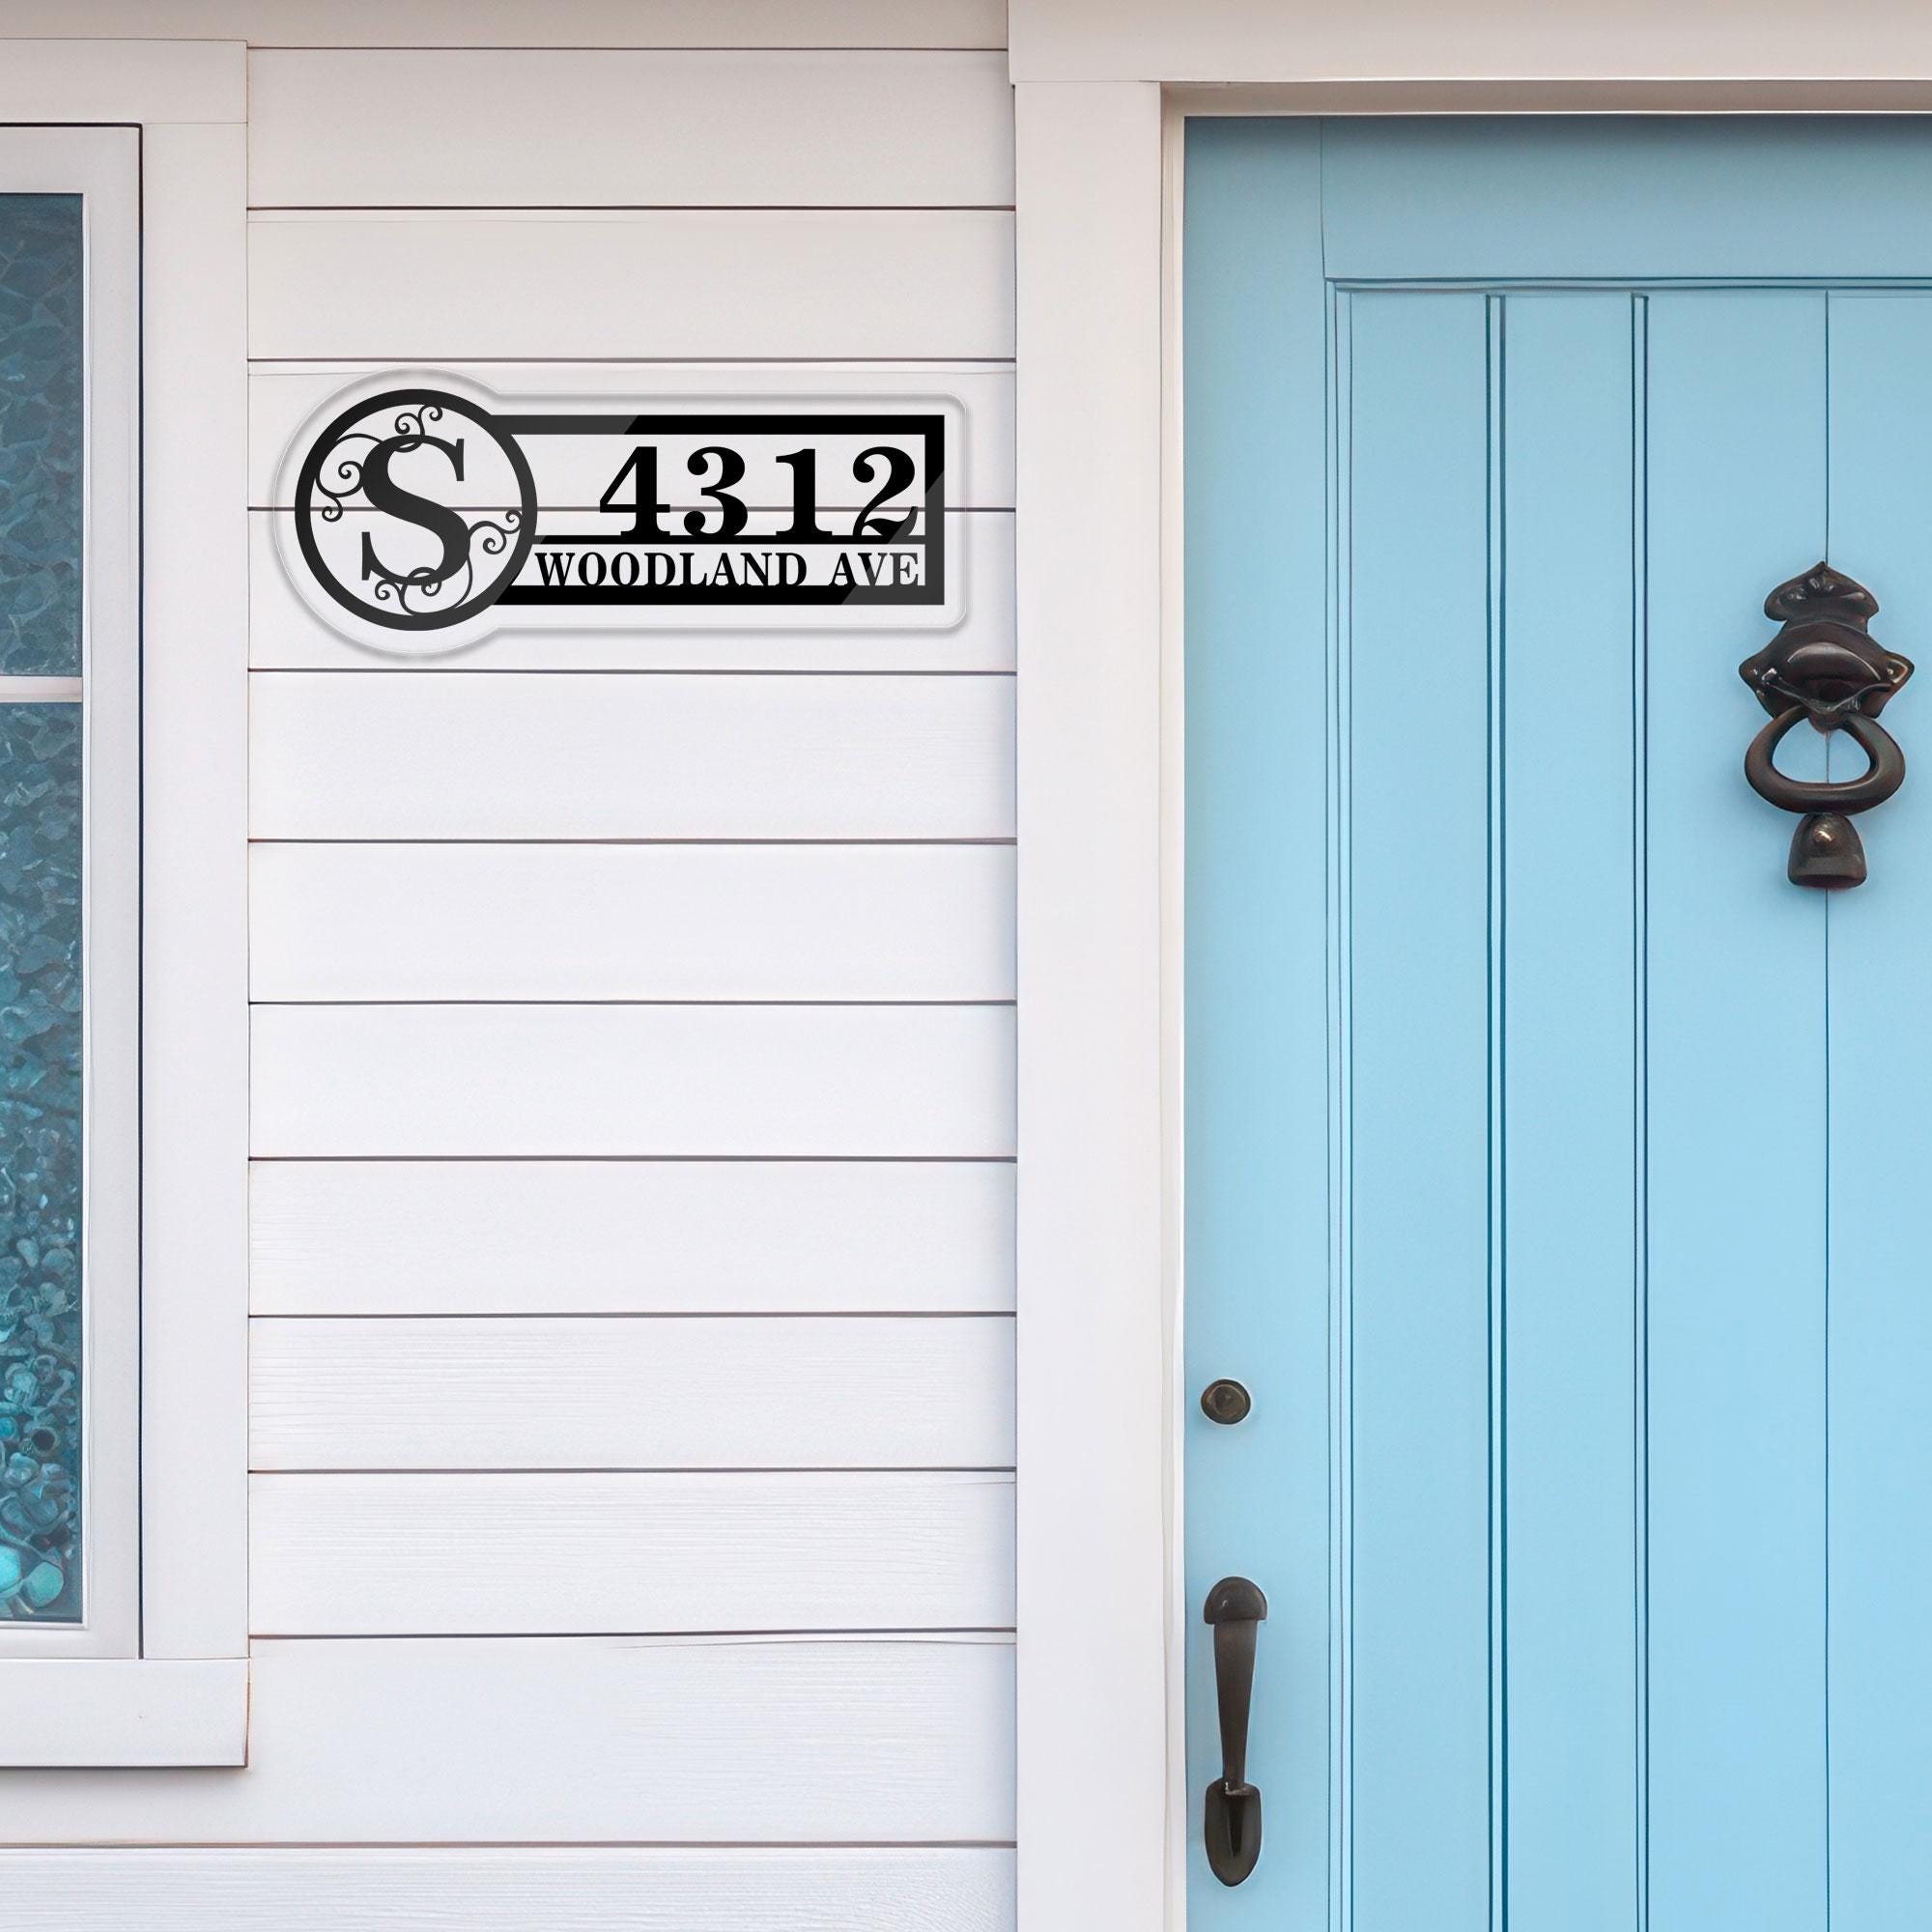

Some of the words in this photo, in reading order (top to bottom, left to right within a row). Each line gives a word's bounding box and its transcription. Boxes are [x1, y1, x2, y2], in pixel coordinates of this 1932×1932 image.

[361, 435, 470, 585] S
[599, 445, 919, 538] 4312
[535, 553, 808, 587] WOODLAND
[832, 553, 919, 587] AVE
